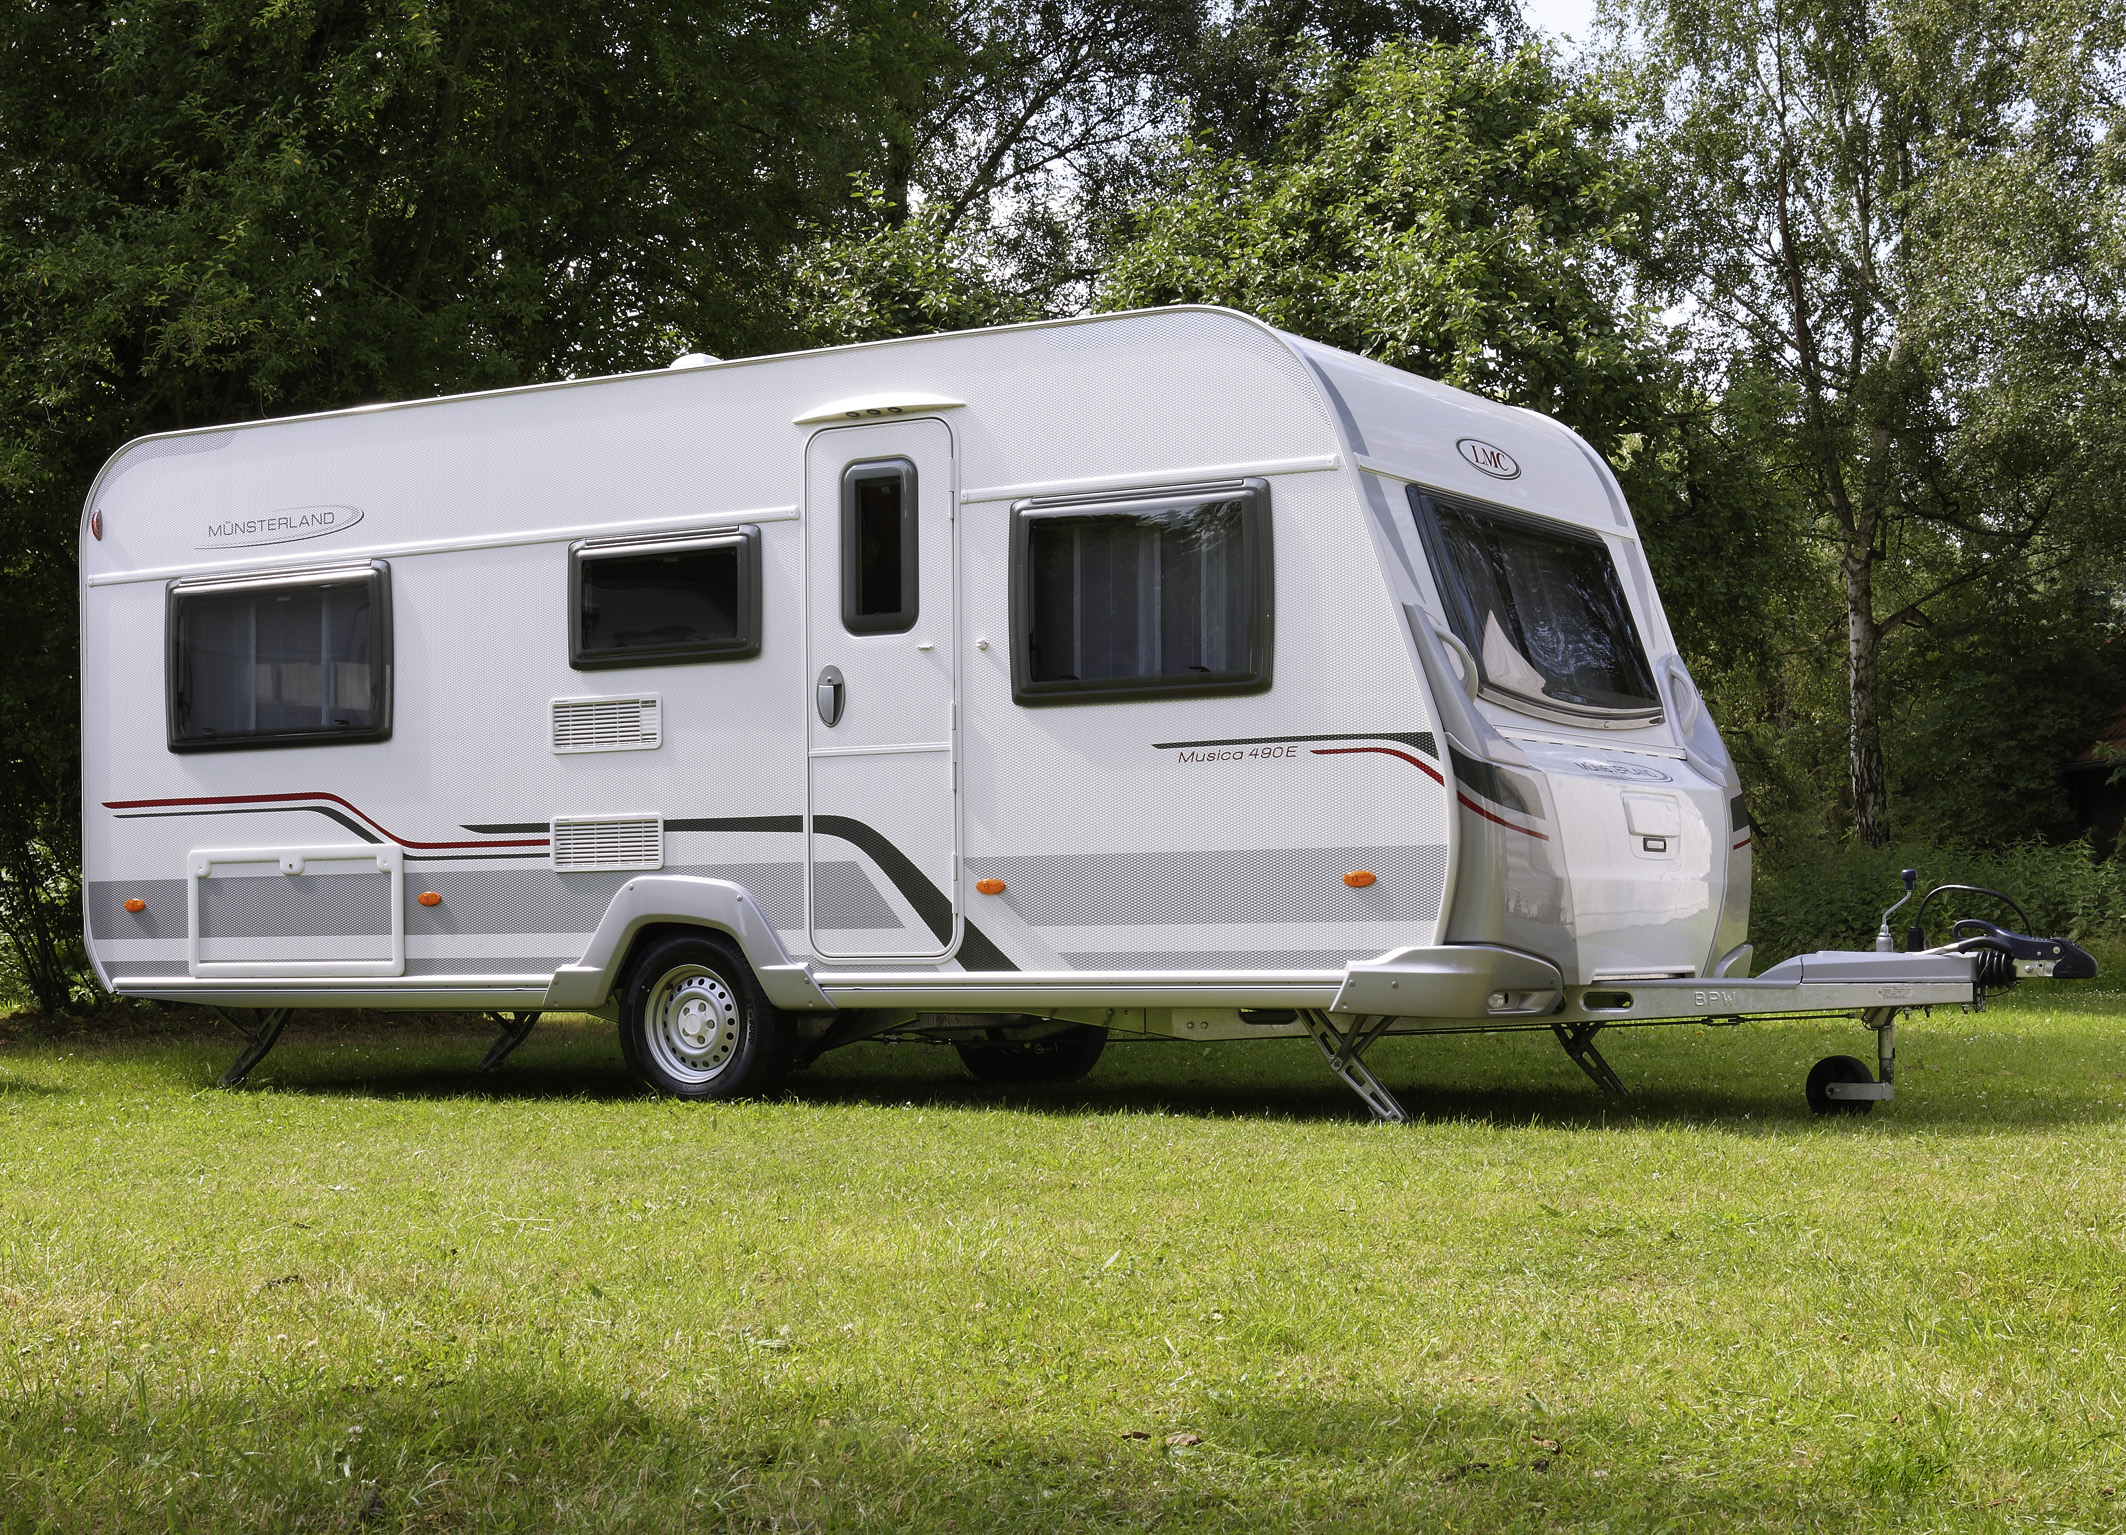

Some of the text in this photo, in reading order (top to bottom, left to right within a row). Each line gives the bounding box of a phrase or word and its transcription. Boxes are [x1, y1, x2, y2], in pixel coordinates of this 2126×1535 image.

[1470, 444, 1509, 472] LMC
[207, 511, 336, 538] MÜNSTERLAND
[1178, 745, 1299, 764] Musica 490E
[1694, 991, 1736, 1007] BPW
